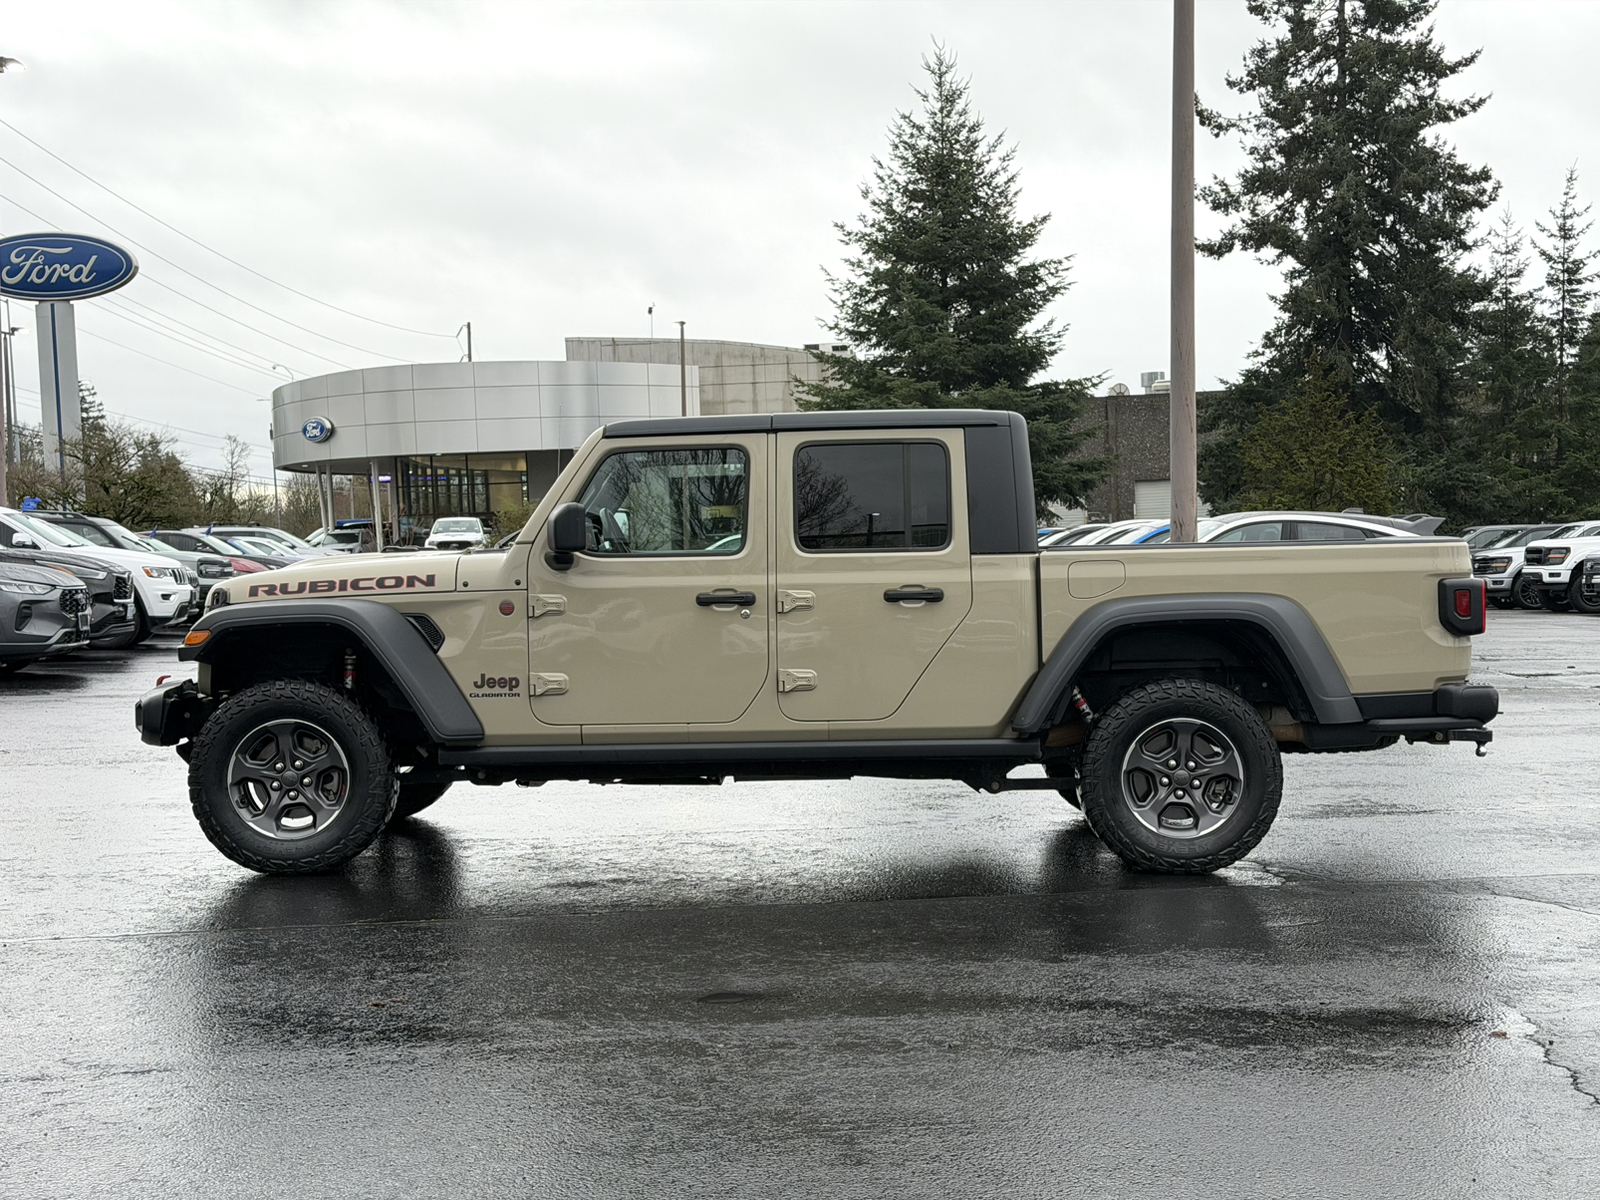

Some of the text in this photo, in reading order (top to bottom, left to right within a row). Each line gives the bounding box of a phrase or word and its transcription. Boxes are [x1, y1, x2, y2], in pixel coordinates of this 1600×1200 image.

[2, 246, 98, 284] Ford
[305, 422, 321, 437] Ford
[248, 574, 436, 598] RUBICON
[473, 673, 520, 691] Jeep
